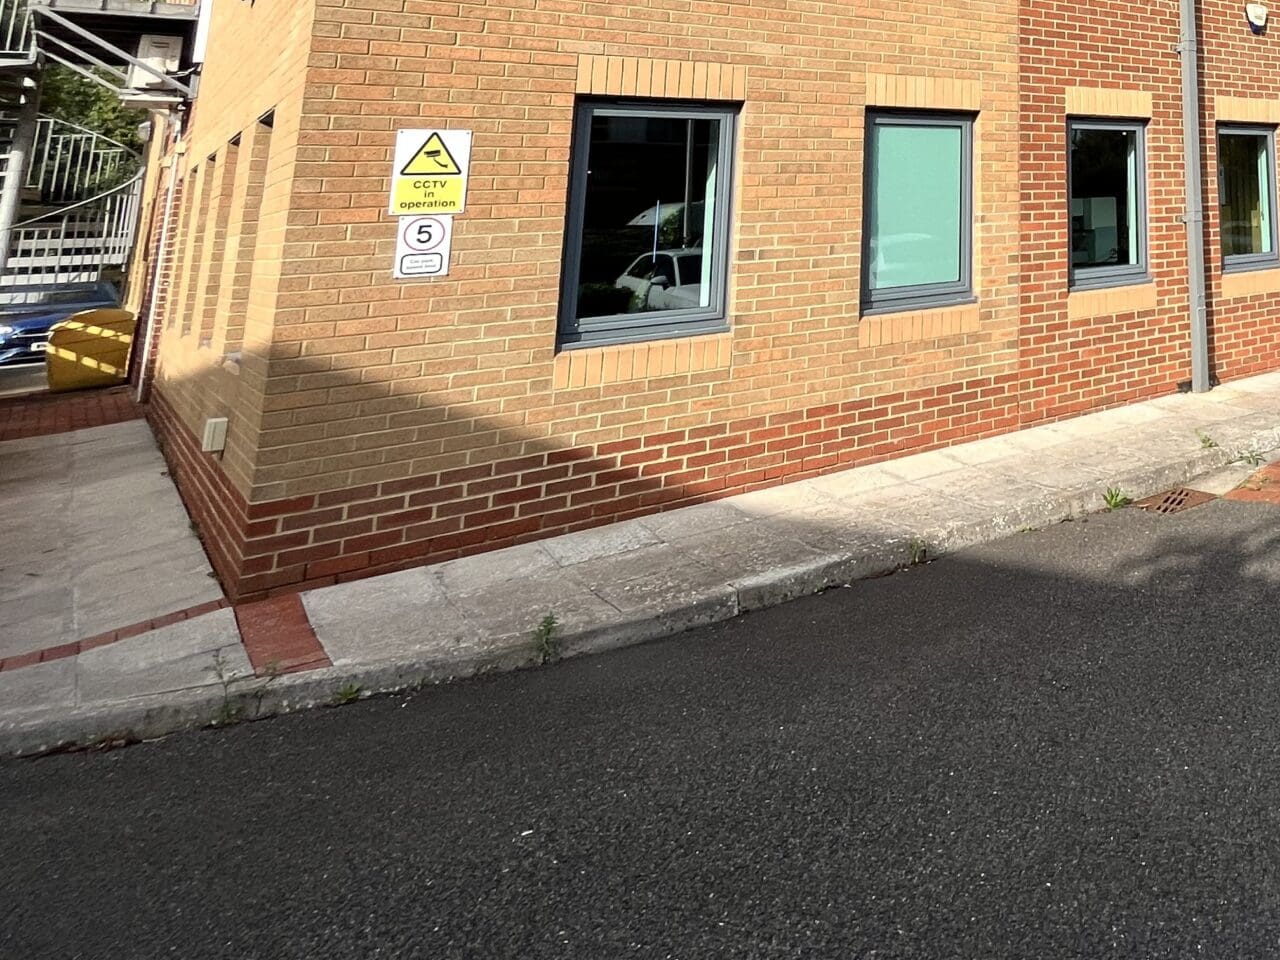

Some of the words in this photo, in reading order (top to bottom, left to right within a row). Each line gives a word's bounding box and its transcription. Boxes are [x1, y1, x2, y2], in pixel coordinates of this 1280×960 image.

[413, 180, 447, 189] CCTV
[424, 190, 434, 198] in
[400, 199, 456, 210] operation
[416, 224, 432, 244] 5
